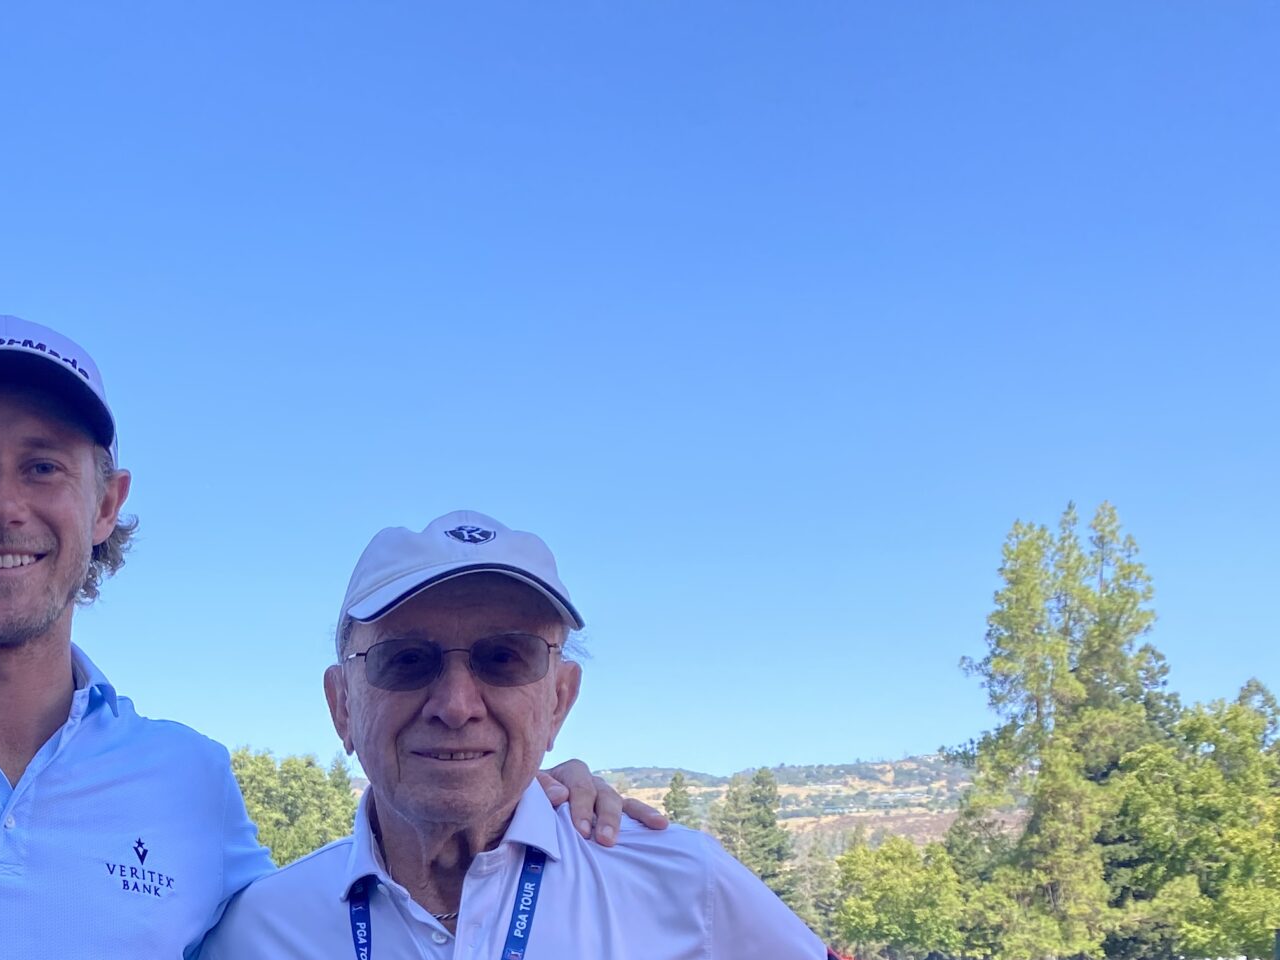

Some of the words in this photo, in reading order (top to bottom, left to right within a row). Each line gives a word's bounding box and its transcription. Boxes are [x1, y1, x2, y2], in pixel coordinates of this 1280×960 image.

[105, 863, 174, 889] VERITEX
[122, 880, 160, 897] BANK
[520, 882, 536, 911] TOUR
[356, 922, 368, 944] PGA
[513, 914, 529, 938] PGA
